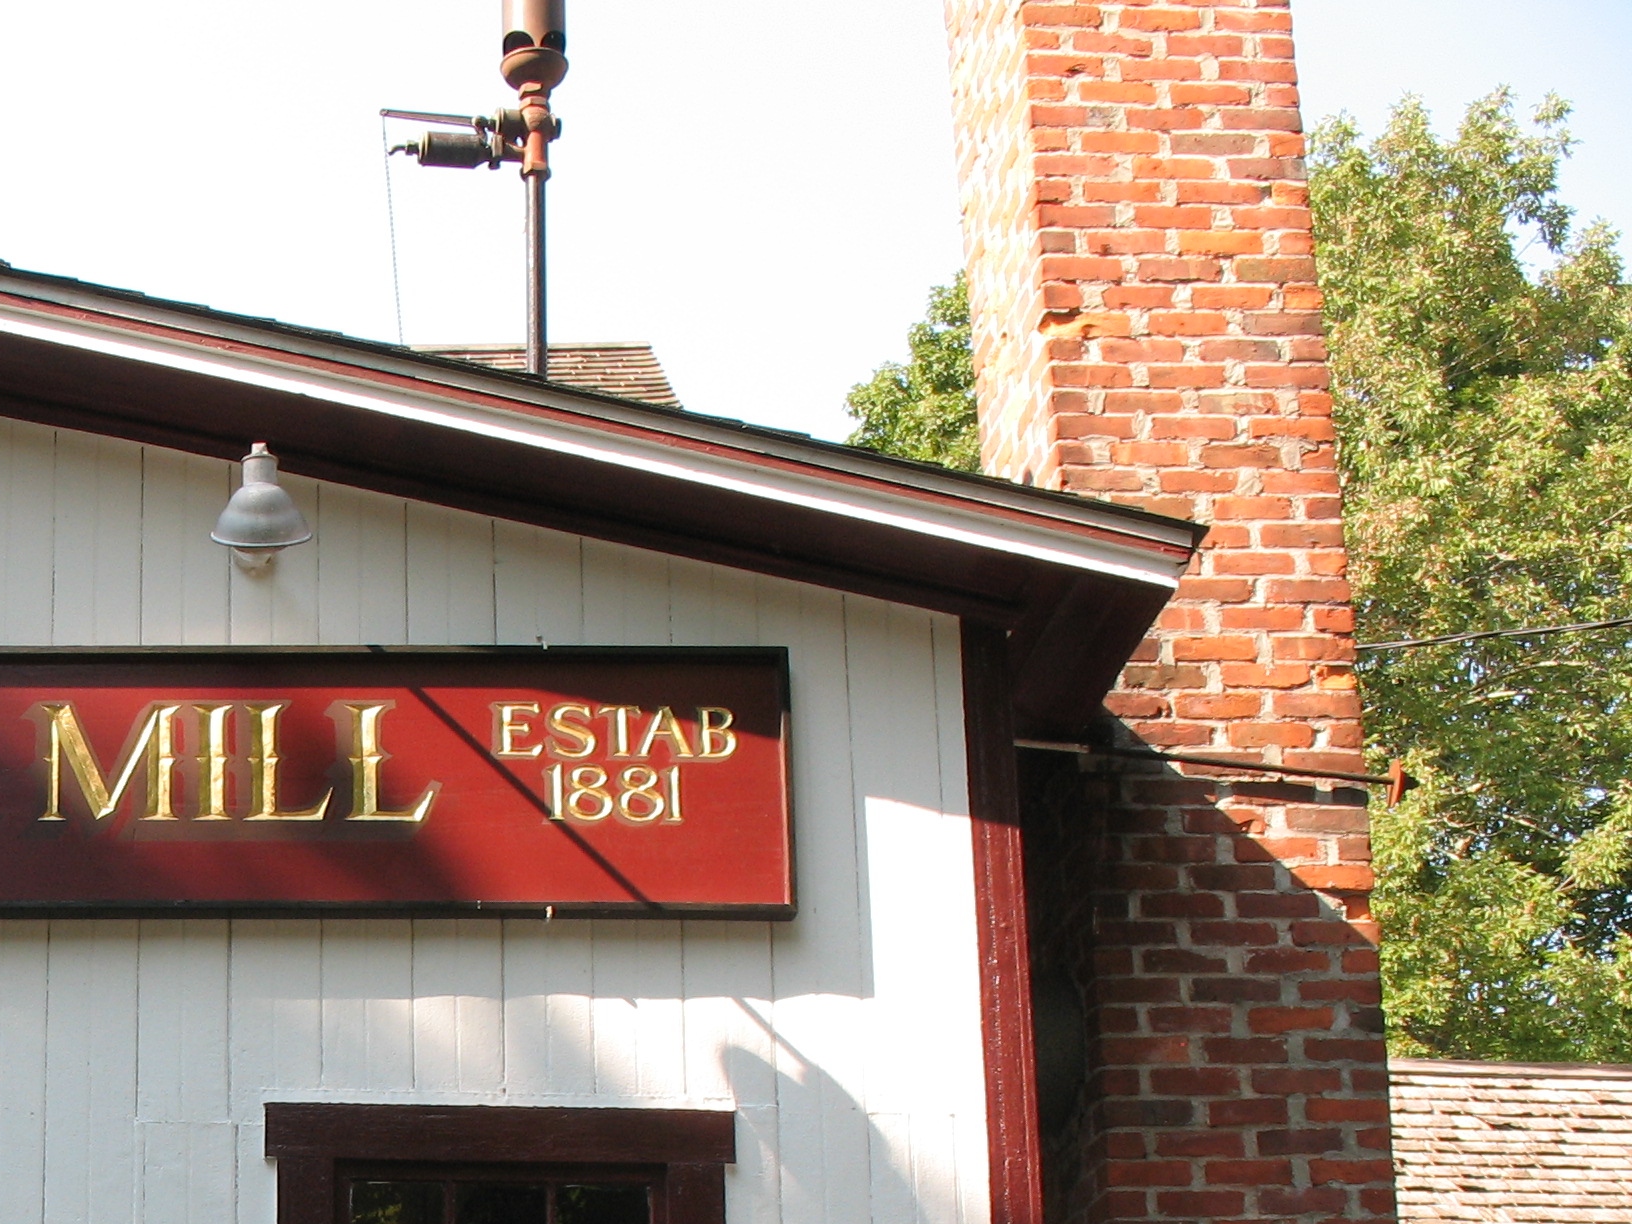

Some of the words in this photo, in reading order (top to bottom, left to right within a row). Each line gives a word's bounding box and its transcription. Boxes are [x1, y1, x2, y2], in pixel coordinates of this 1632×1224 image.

[497, 701, 739, 761] ESTAB
[38, 701, 439, 824] MILL
[543, 763, 686, 825] 1881
